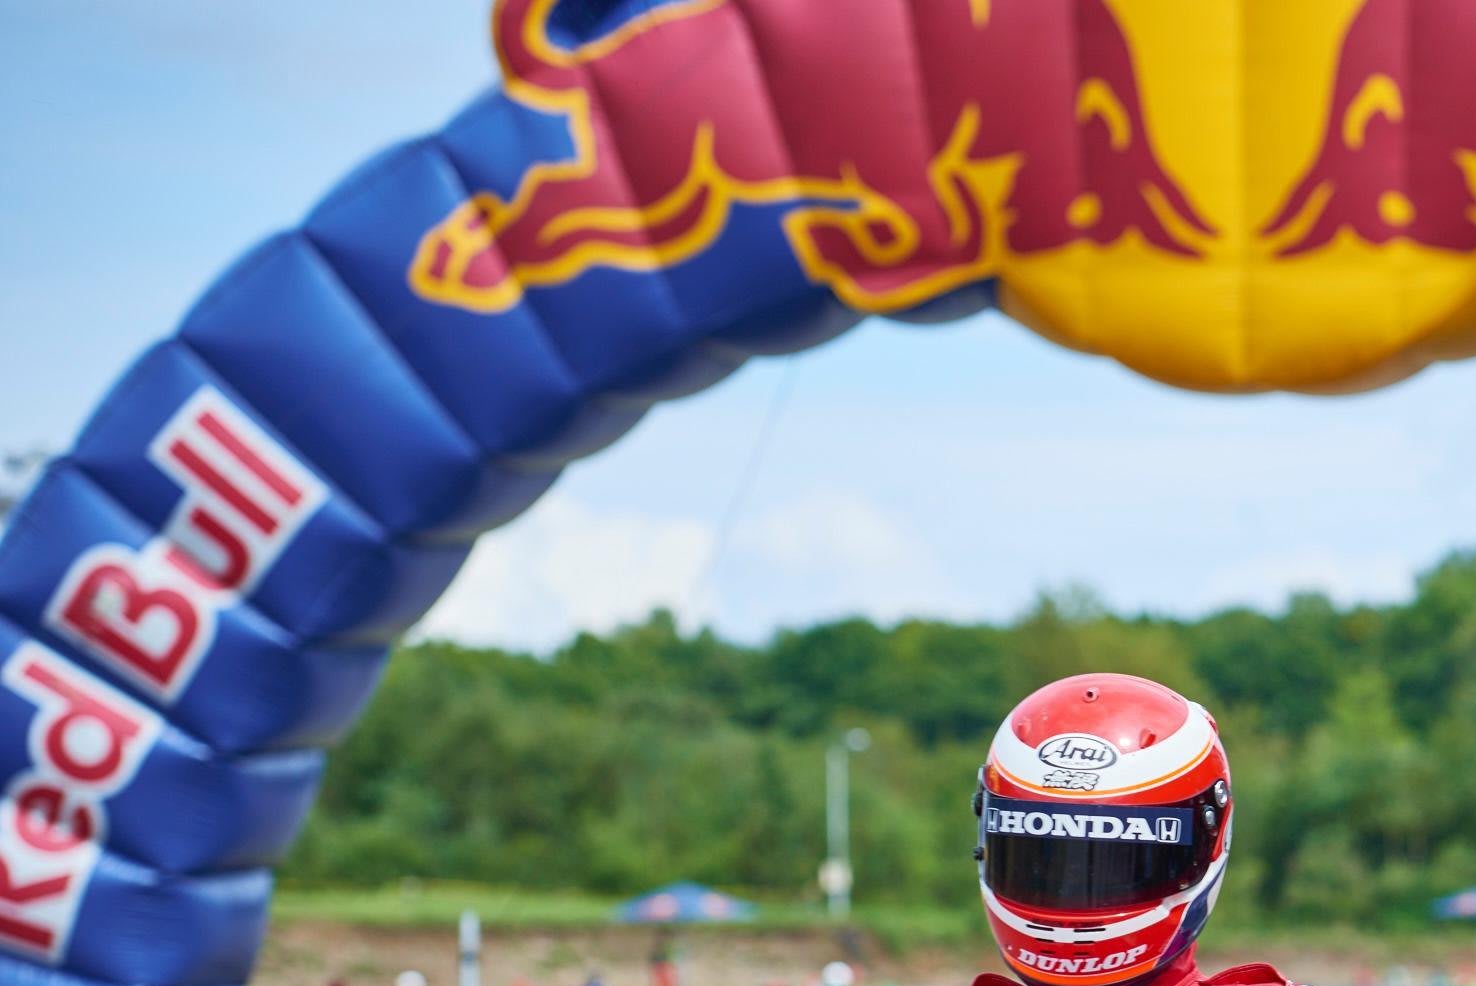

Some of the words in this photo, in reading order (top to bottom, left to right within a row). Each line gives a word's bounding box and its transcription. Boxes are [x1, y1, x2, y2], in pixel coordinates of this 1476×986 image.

[61, 409, 303, 689] Bull
[1043, 739, 1107, 762] Arai
[1000, 811, 1157, 841] HONDA
[1017, 944, 1148, 973] DUNLOP
